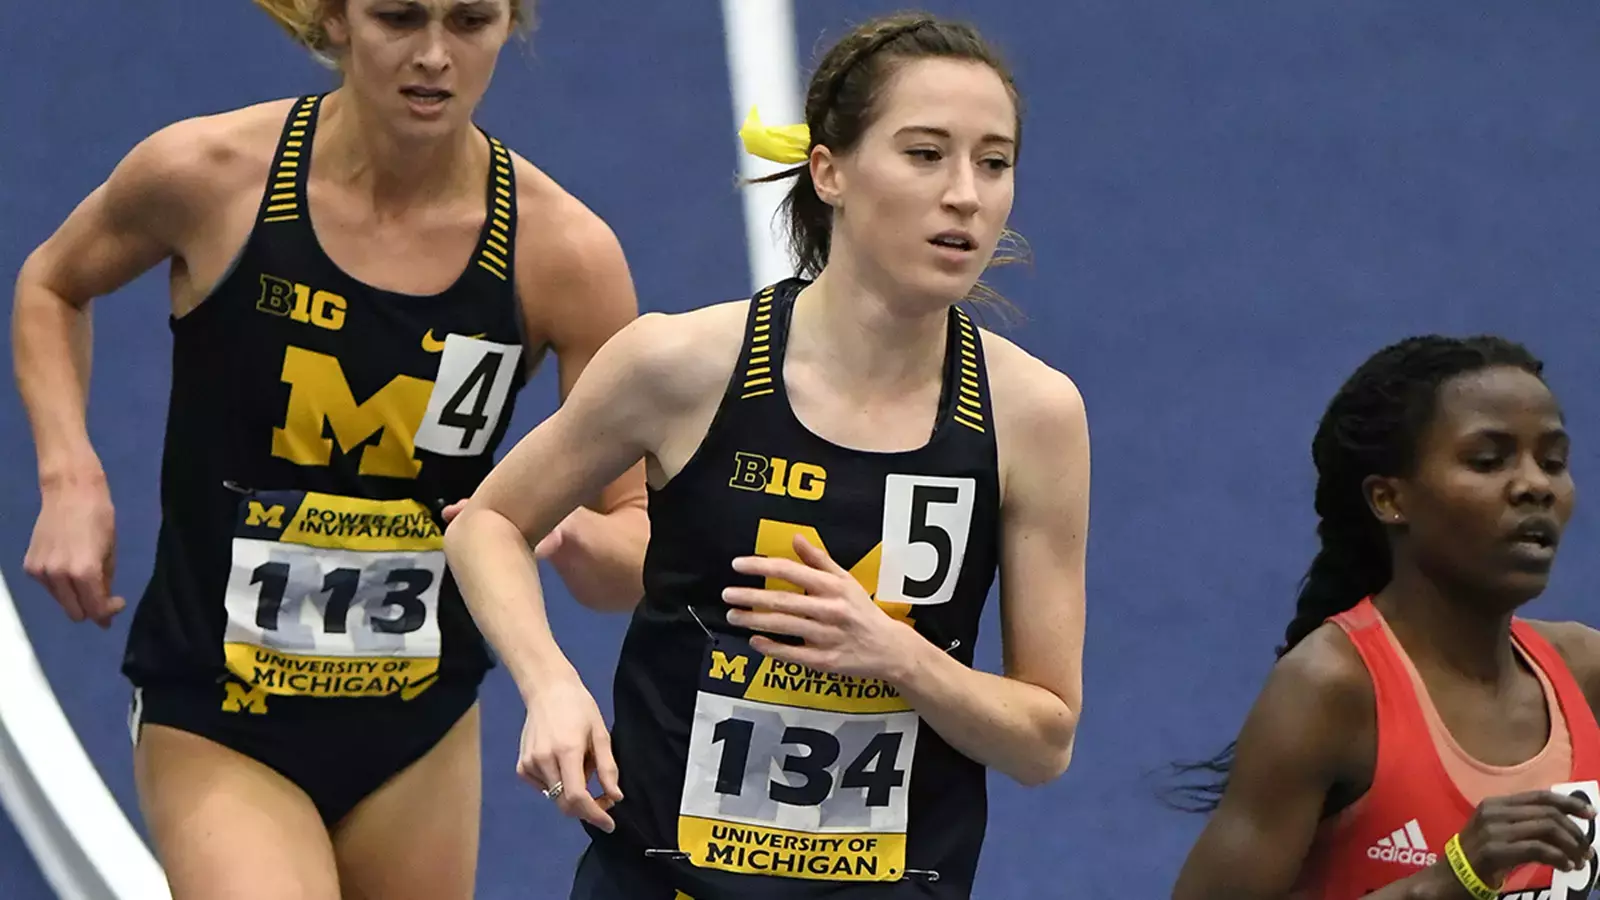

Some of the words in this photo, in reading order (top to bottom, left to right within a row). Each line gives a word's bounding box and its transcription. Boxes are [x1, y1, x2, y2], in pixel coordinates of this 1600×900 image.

[271, 345, 434, 479] M
[438, 351, 504, 449] 4
[245, 501, 285, 528] M
[299, 520, 438, 539] INVITATIONA
[306, 508, 387, 526] POWER
[902, 484, 959, 600] 5
[250, 562, 434, 635] 113
[255, 651, 377, 674] UNIVERSITY
[382, 661, 411, 674] OF
[708, 651, 748, 683] M
[252, 667, 408, 693] MICHIGAN
[763, 672, 900, 699] INVITATION
[221, 681, 268, 714] M
[711, 718, 905, 807] 134
[711, 825, 843, 853] UNIVERSITY
[848, 838, 878, 853] OF
[705, 843, 877, 876] MICHIGAN
[1367, 844, 1438, 867] adidas
